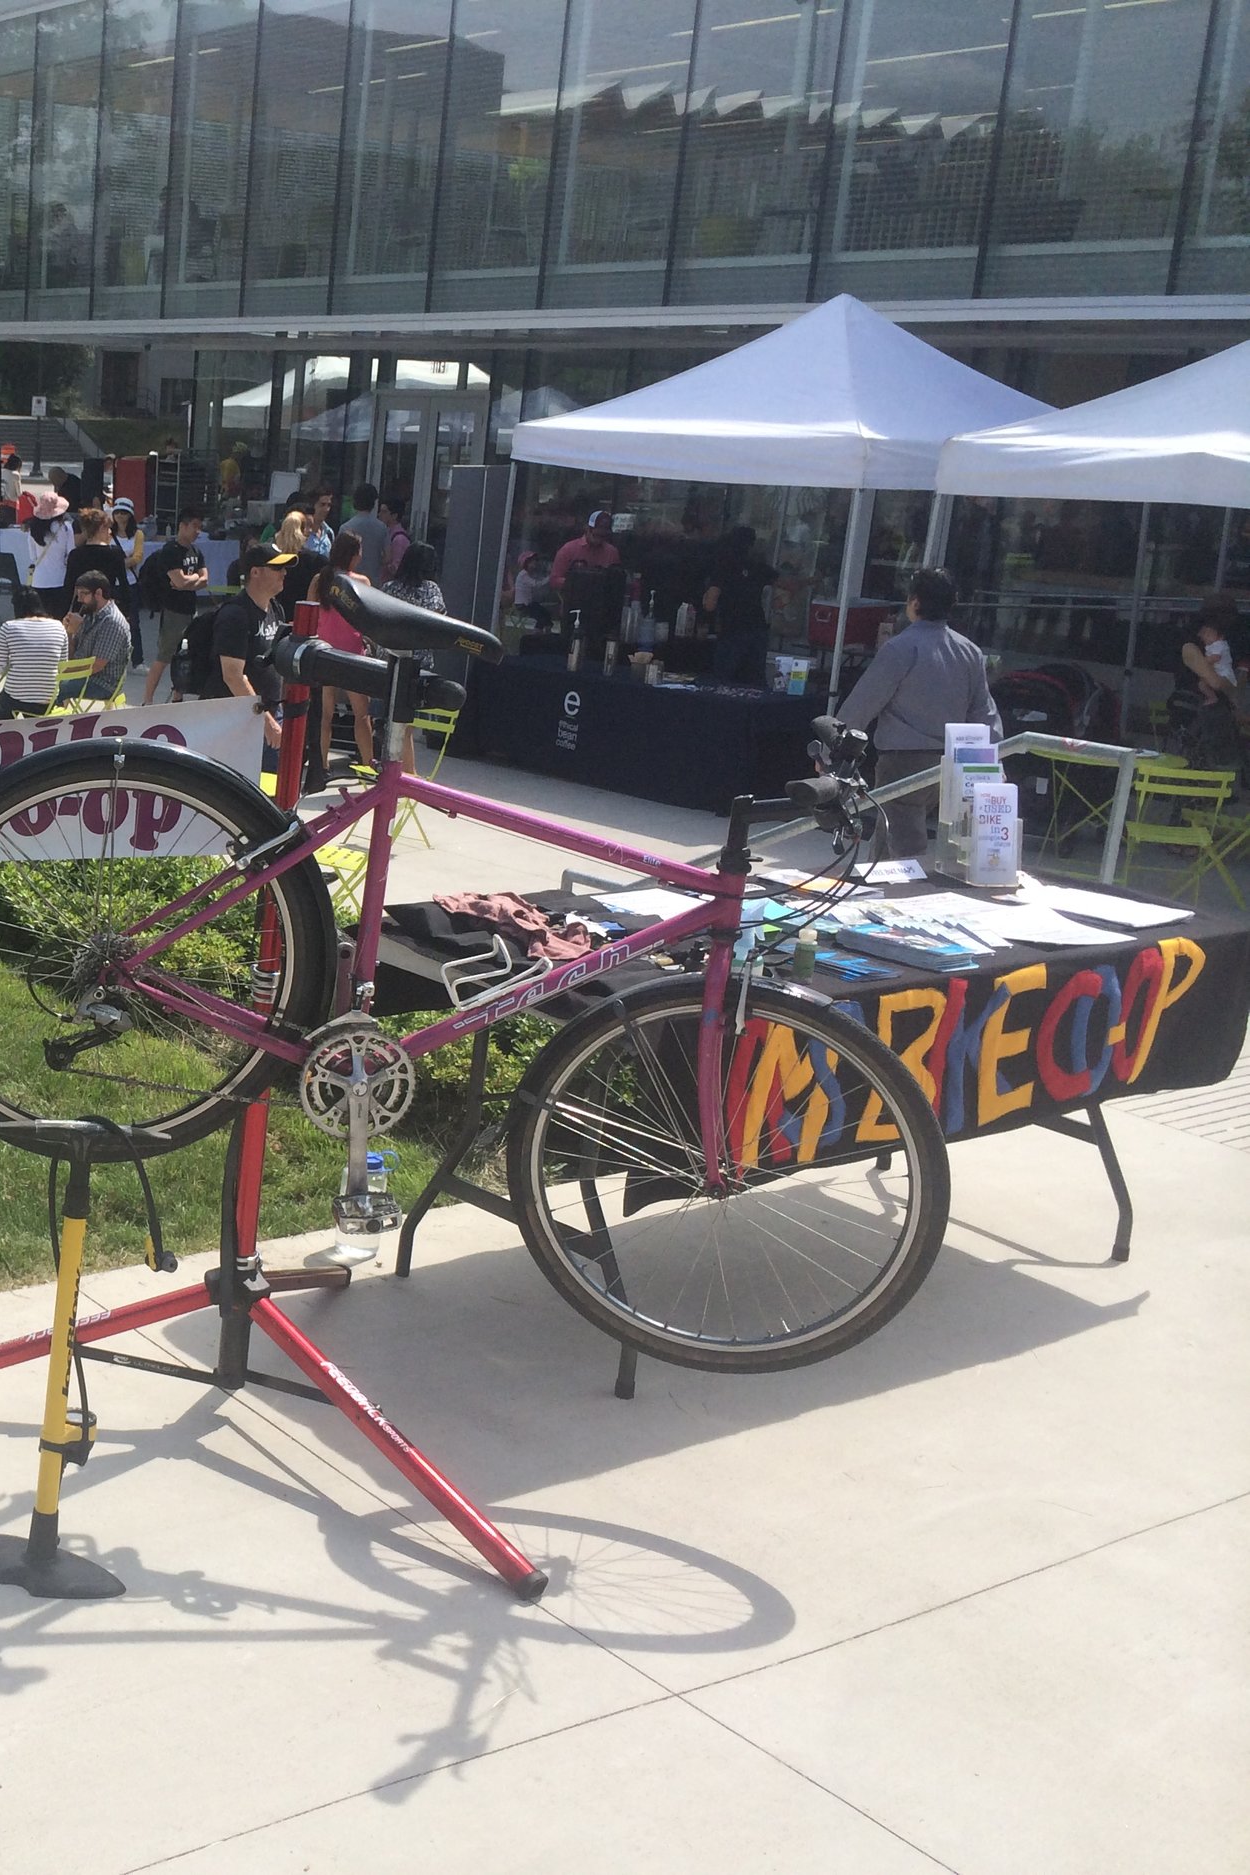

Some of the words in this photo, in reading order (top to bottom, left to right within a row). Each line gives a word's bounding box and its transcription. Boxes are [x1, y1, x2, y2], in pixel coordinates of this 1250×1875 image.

[564, 691, 581, 716] e
[558, 727, 578, 741] bean
[991, 795, 1007, 805] BUY
[984, 805, 1012, 814] USED
[7, 786, 183, 851] o-op
[979, 814, 1002, 825] BIKE
[1000, 826, 1009, 841] 3
[855, 962, 1048, 1143] BIKE
[1036, 936, 1207, 1101] CO-OP
[320, 1361, 393, 1427] FEEDBACK
[382, 1422, 411, 1453] SPORTS
